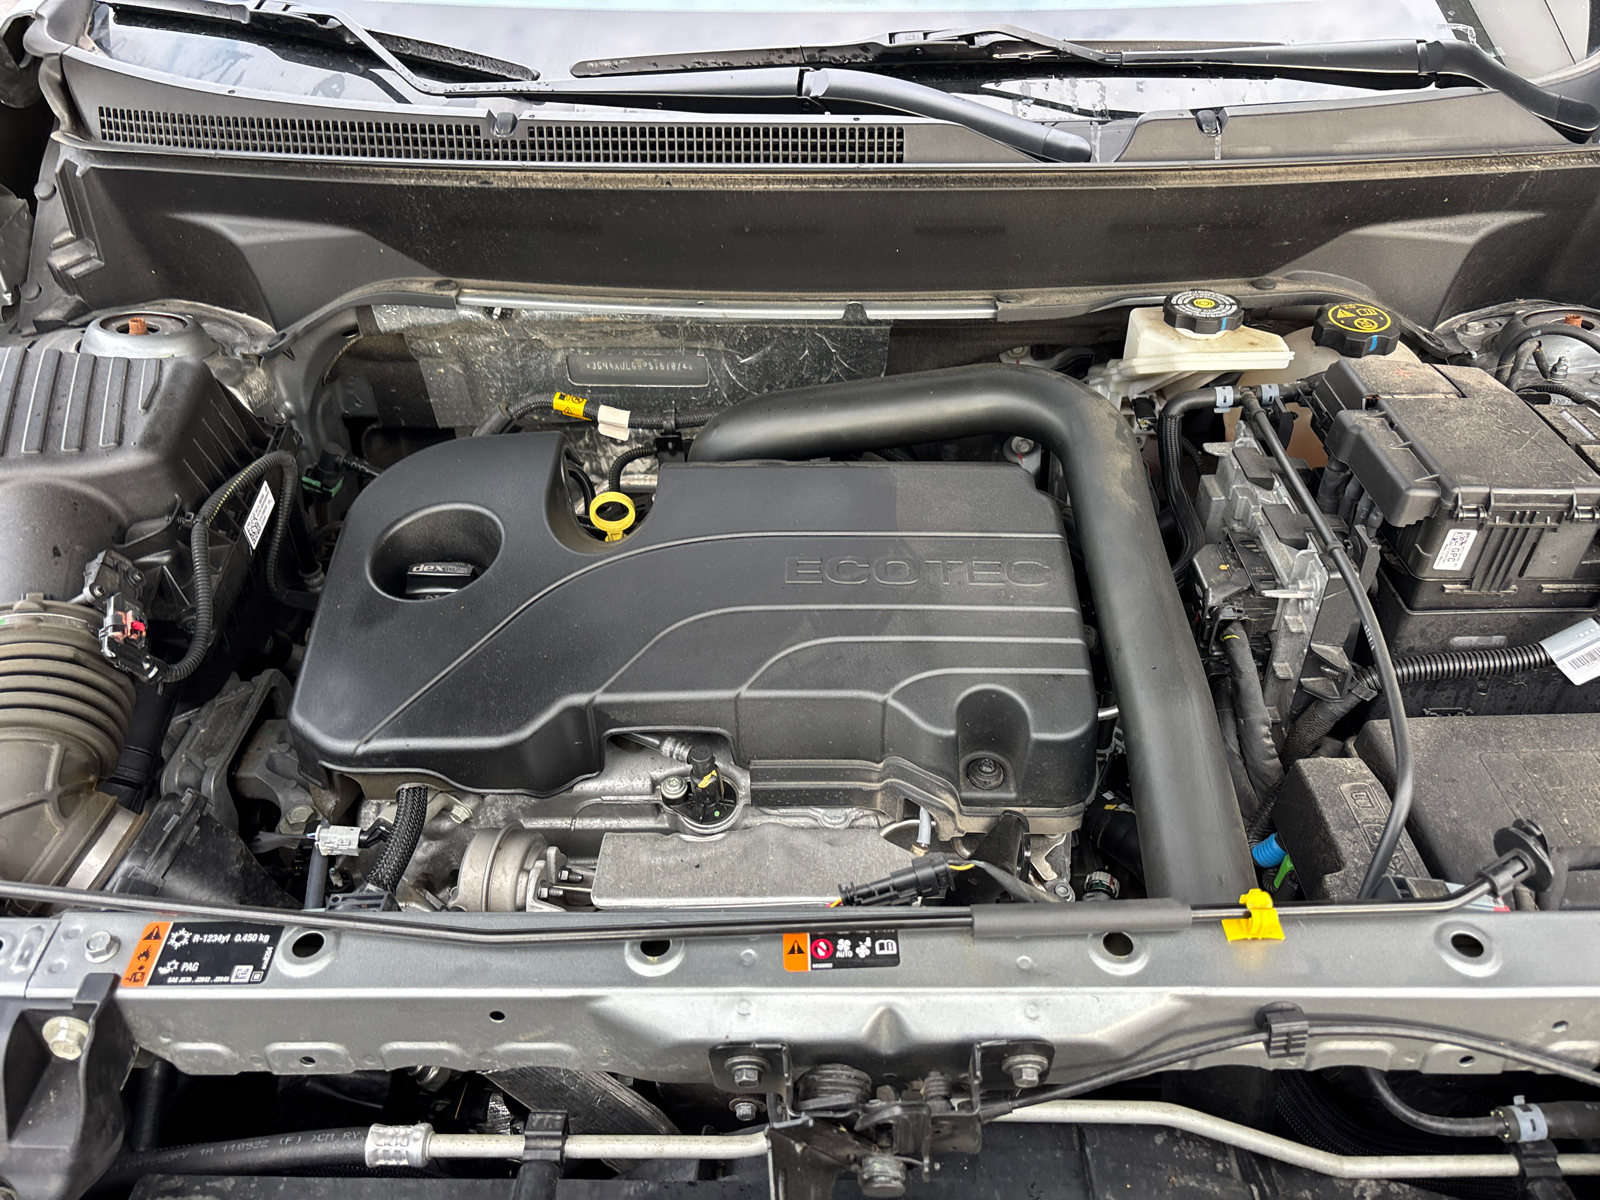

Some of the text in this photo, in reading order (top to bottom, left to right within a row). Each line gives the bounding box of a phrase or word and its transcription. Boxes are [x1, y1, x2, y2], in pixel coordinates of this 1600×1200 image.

[785, 557, 1050, 587] ECOTEC
[192, 933, 270, 944] R-1234yf 0.450 kg
[836, 950, 853, 958] AUTO
[180, 962, 200, 972] PAG
